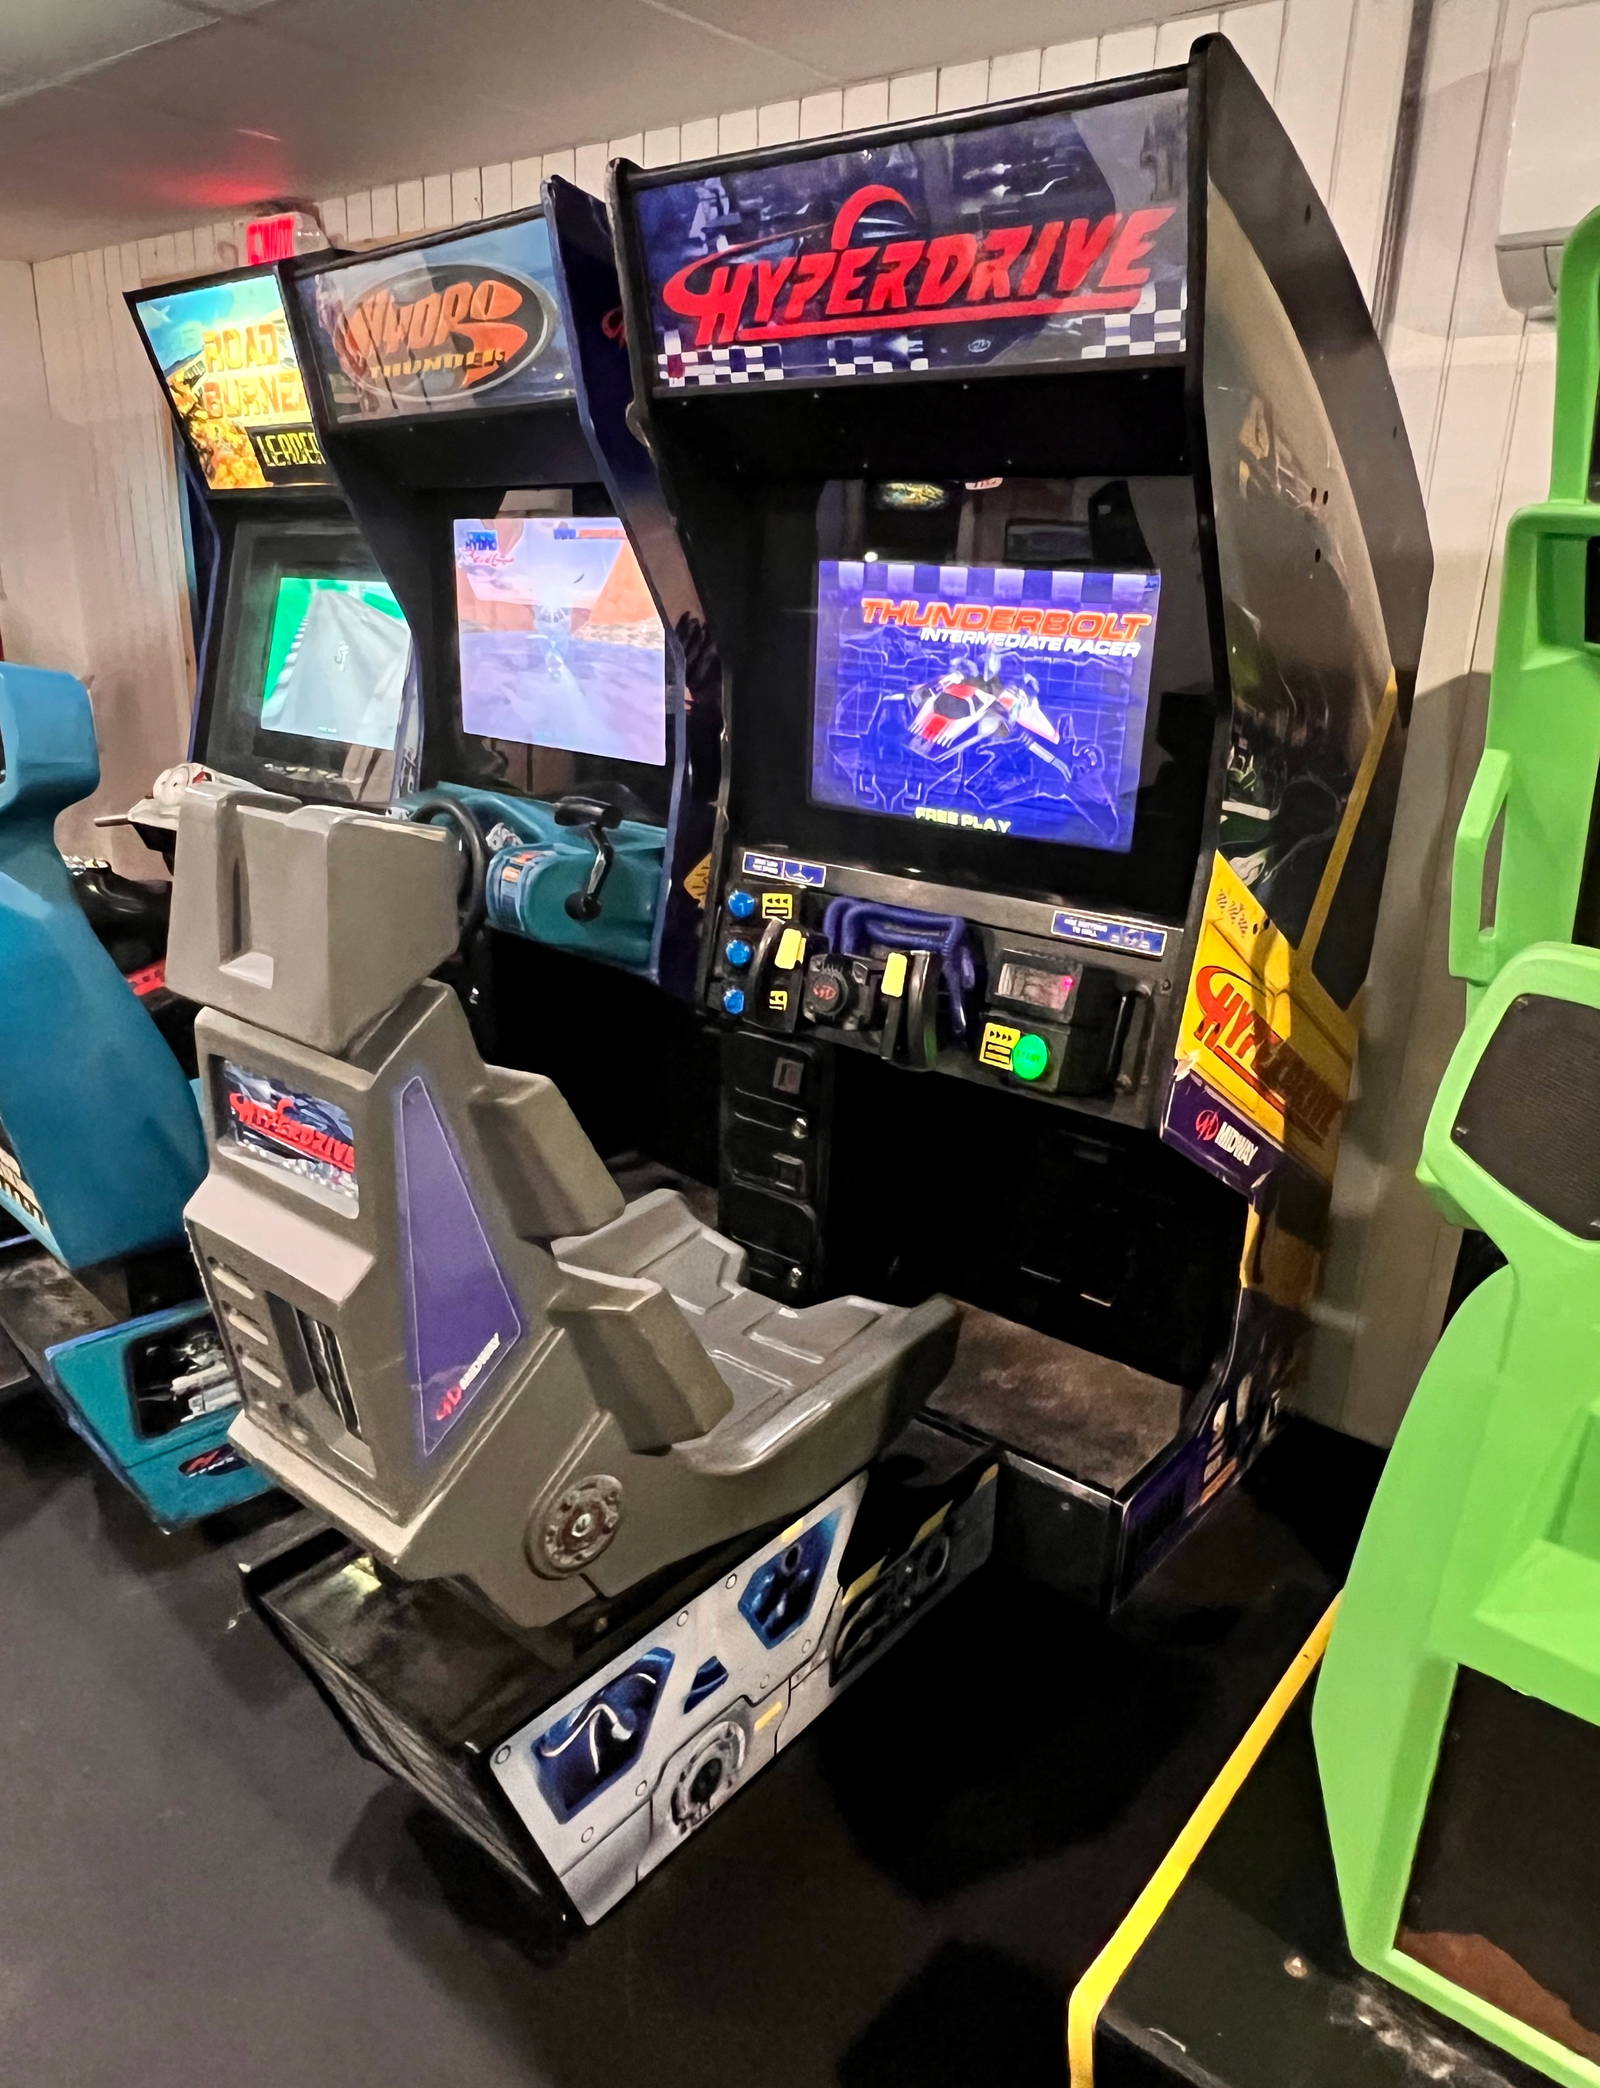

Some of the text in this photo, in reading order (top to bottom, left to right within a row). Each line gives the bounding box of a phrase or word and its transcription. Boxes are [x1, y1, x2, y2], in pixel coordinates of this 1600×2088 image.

[662, 184, 1177, 346] HYPERDRIVE
[202, 323, 280, 373] ROAD
[370, 349, 506, 379] THUNDER
[202, 371, 306, 420] BURNE
[861, 597, 1153, 641] THUNDERBOLT
[920, 627, 1142, 658] INTERMEDIATE RACER
[915, 806, 1011, 834] FREE PLAY
[1214, 1122, 1259, 1157] MIDWAY
